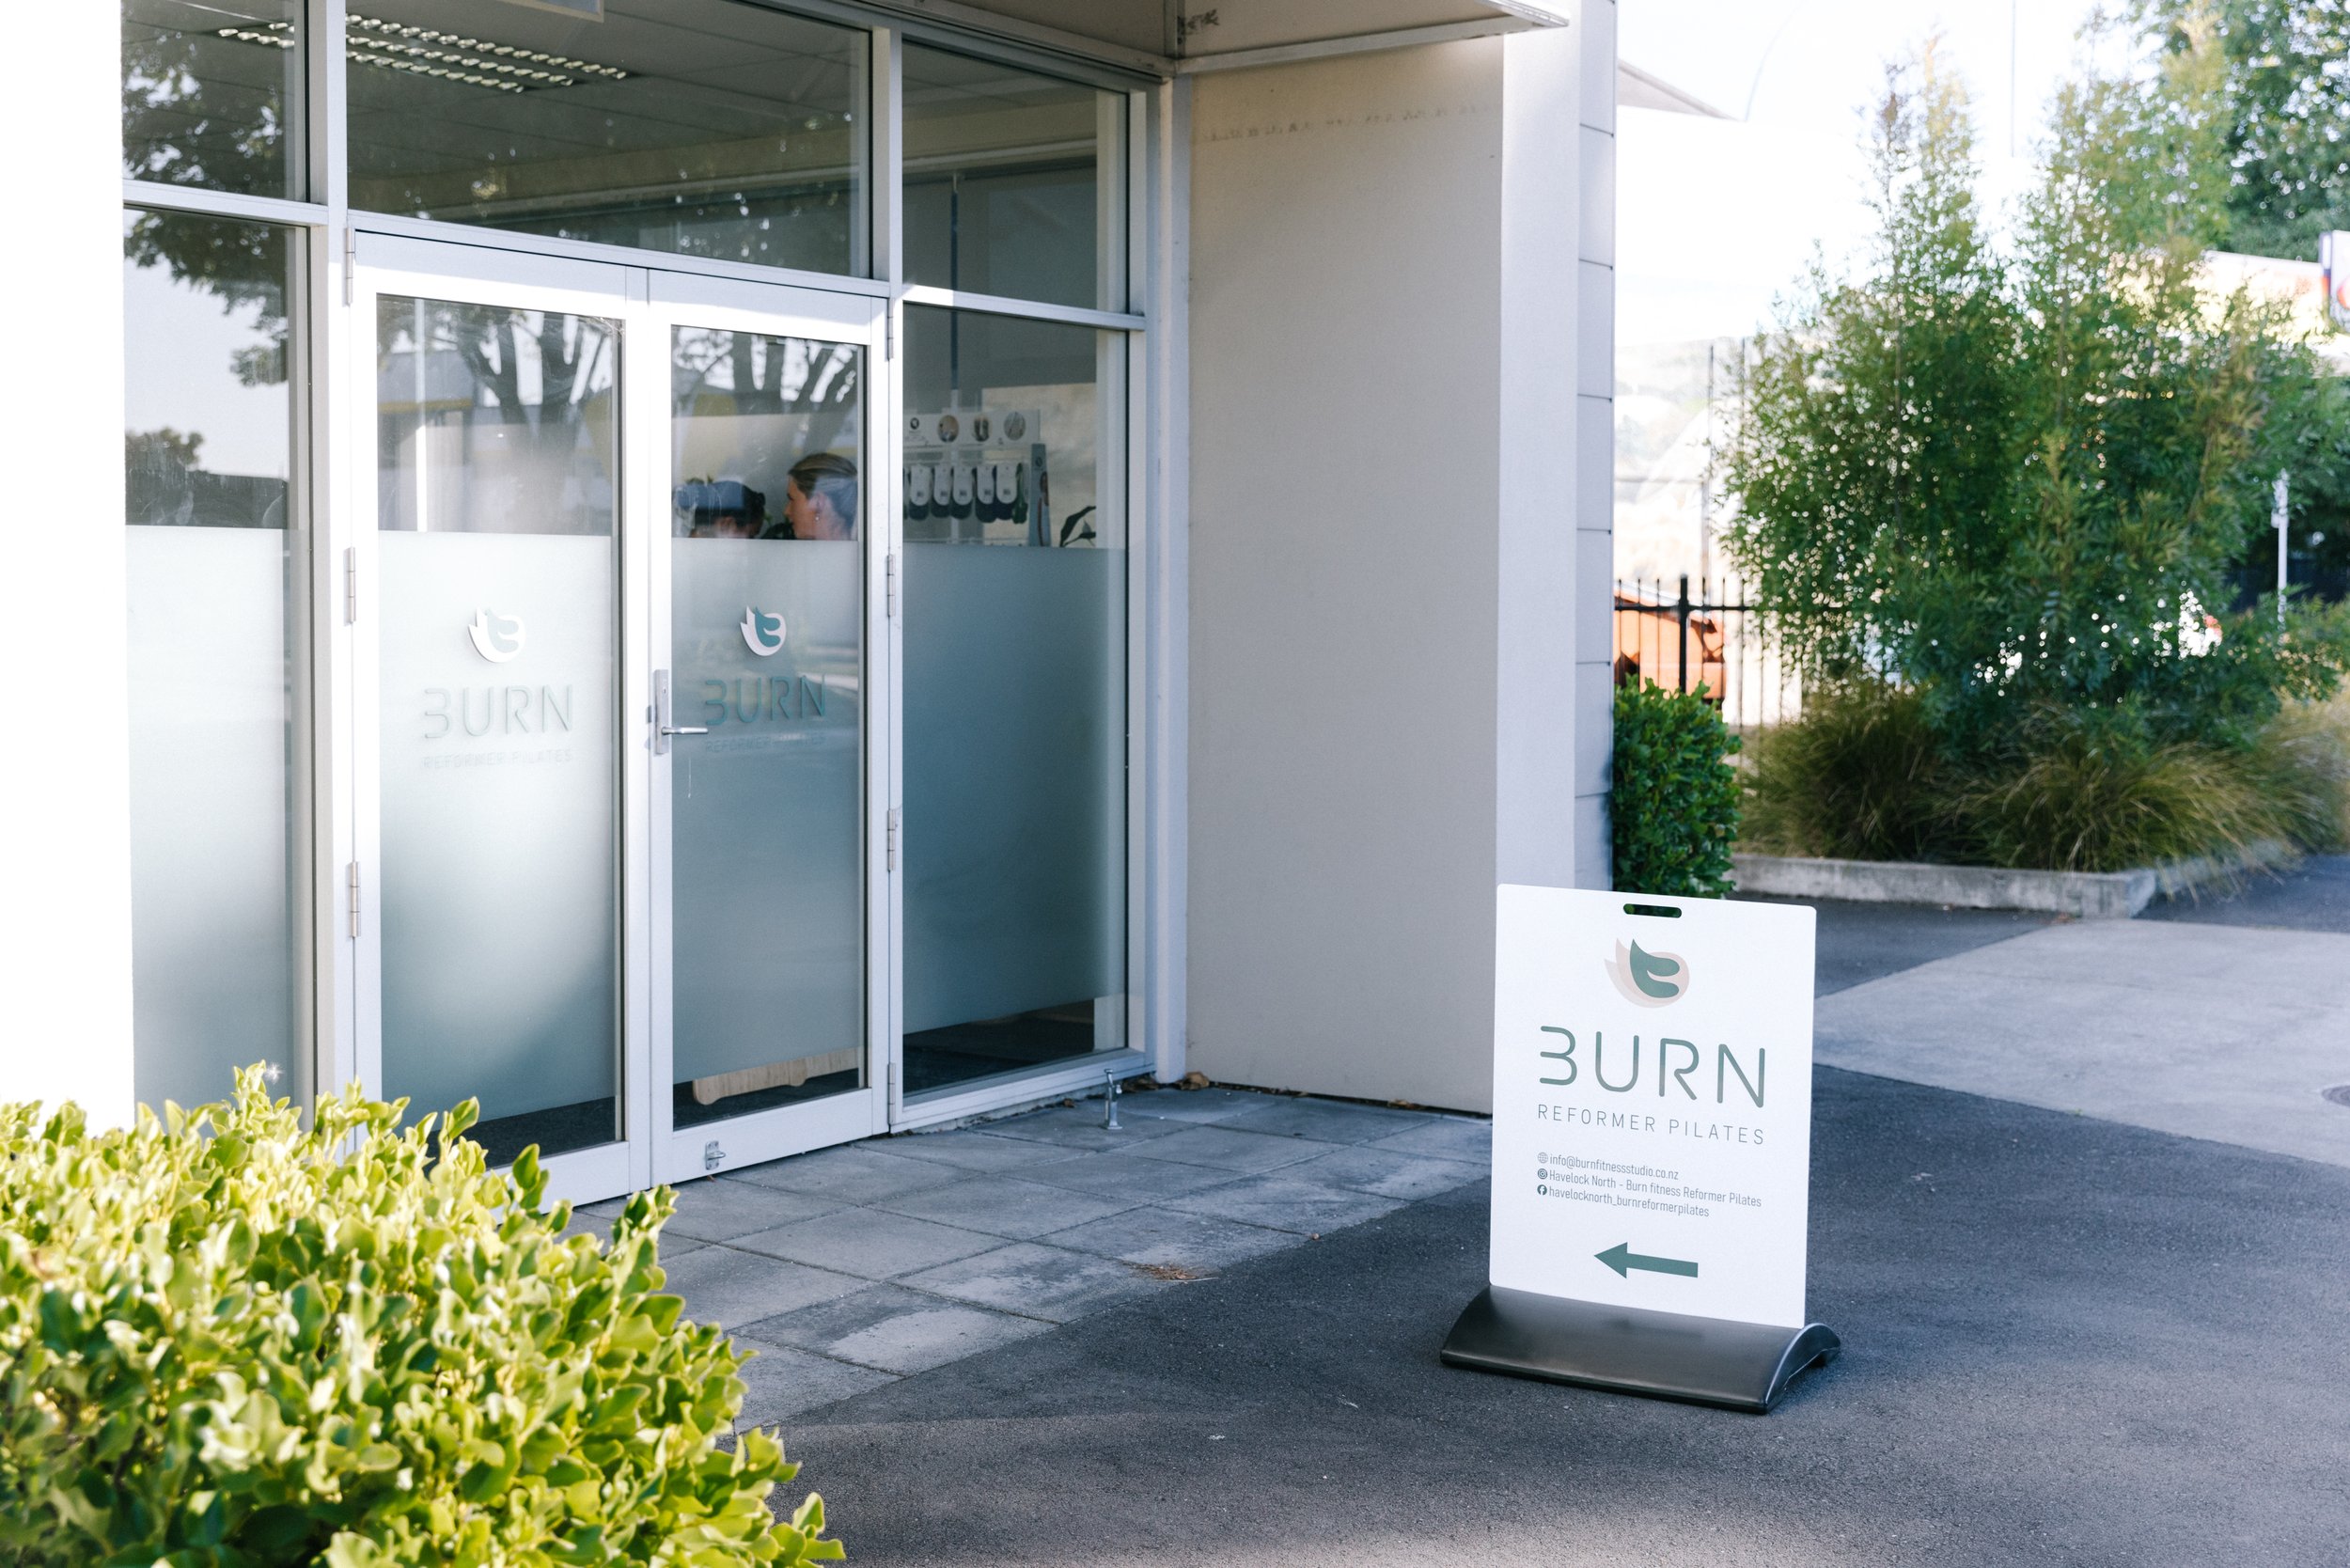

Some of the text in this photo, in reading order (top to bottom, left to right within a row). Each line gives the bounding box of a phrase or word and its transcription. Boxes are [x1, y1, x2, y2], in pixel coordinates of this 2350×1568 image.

[423, 684, 572, 739] BURN
[705, 674, 826, 726] BURN
[1539, 1025, 1765, 1108] BURN
[1538, 1104, 1764, 1145] REFORMER PILATES
[1549, 1153, 1679, 1181] info@burnfitnessstudio.co.nz
[1548, 1186, 1710, 1217] havelocknorth_burnreformerpilates
[1549, 1169, 1590, 1185] Havelock
[1591, 1175, 1616, 1189] North
[1626, 1179, 1647, 1193] Burn
[1650, 1182, 1681, 1198] fitness
[1684, 1186, 1726, 1203] Reformer
[1729, 1192, 1762, 1208] Pilates
